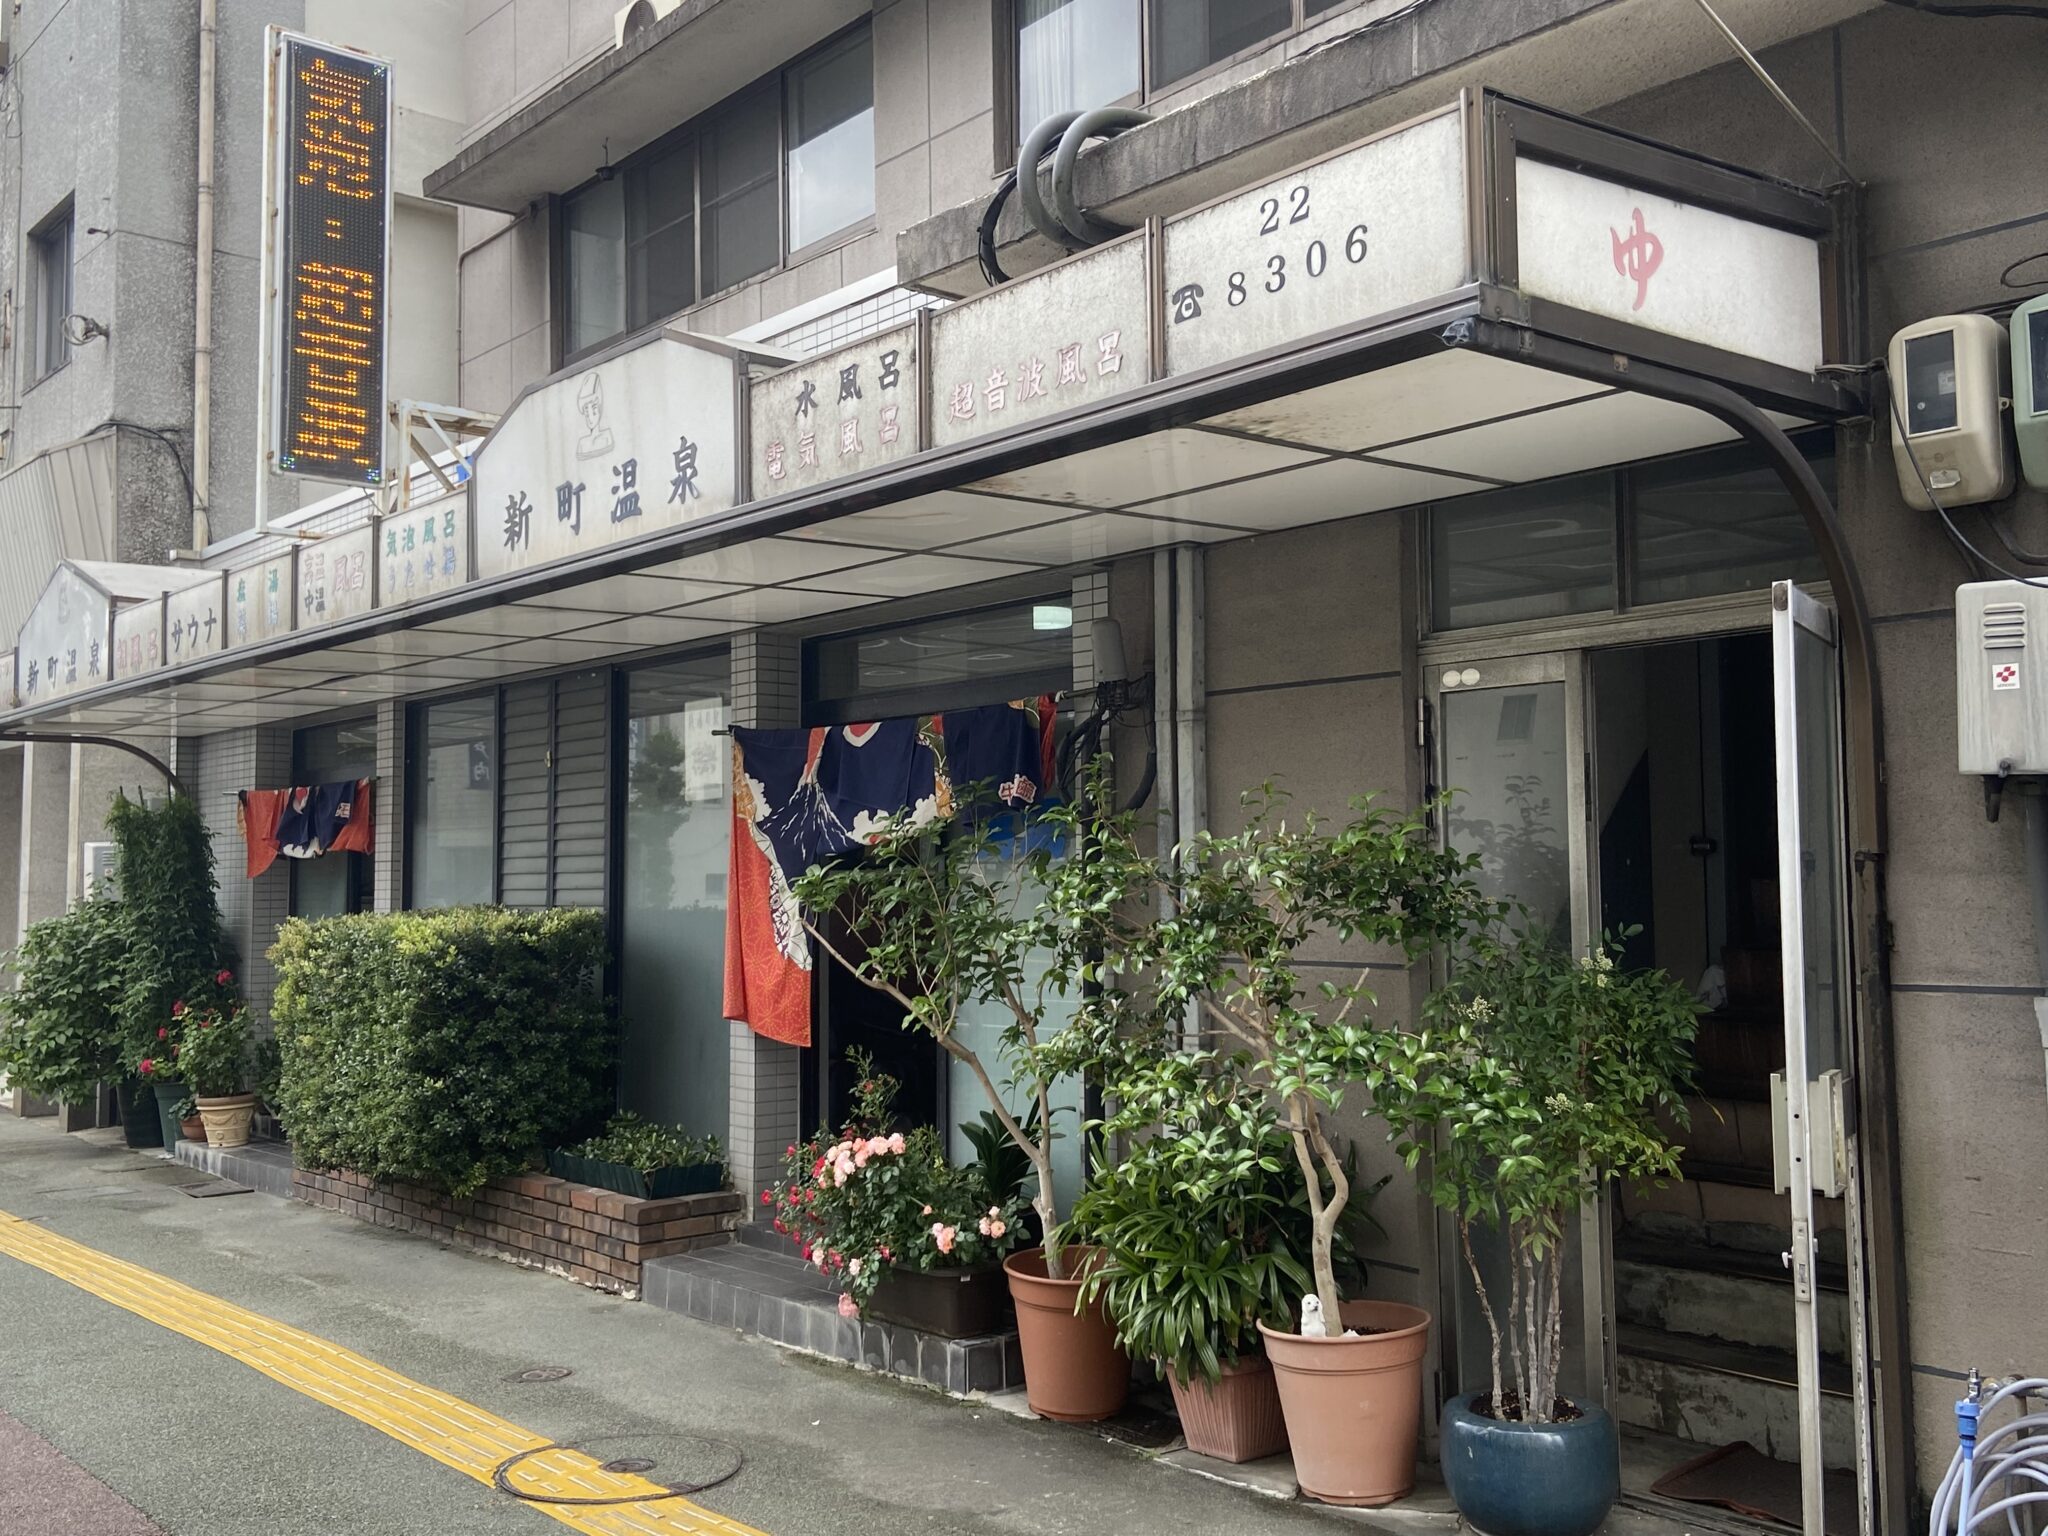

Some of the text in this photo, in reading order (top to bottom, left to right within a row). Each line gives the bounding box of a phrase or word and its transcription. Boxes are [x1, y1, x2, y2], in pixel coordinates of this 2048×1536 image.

[1259, 185, 1310, 236] 22
[1227, 224, 1368, 308] 8306
[1610, 207, 1664, 312] ゆ
[795, 349, 901, 416] 水風呂
[948, 329, 1124, 424] 超音波風呂
[764, 405, 901, 480] 電気風呂
[504, 435, 701, 552] 新町温泉
[386, 509, 455, 557] 気泡風呂
[388, 546, 456, 593] うたせ湯
[171, 607, 217, 652] サウナ
[26, 637, 100, 696] 新町温泉
